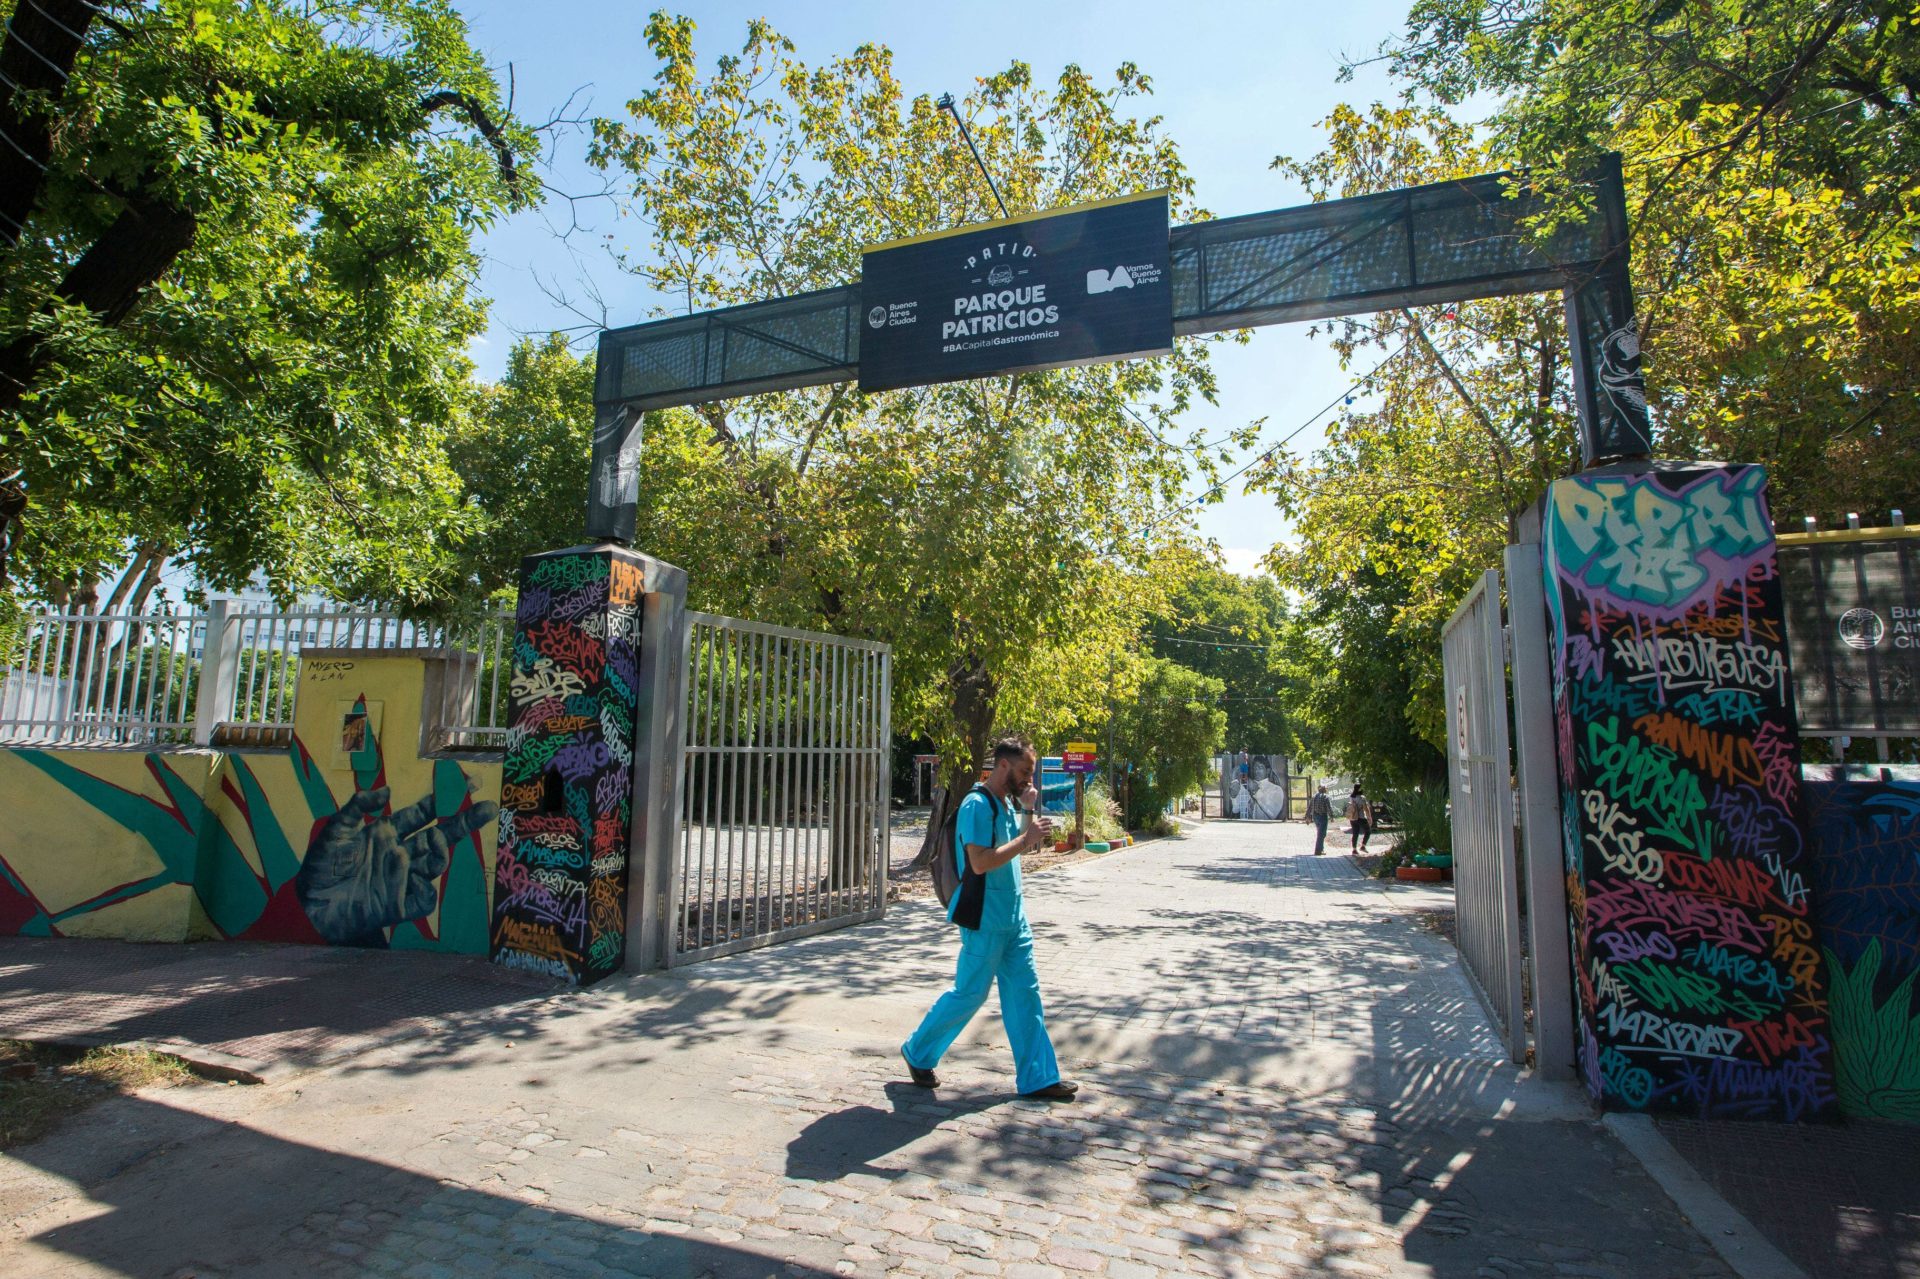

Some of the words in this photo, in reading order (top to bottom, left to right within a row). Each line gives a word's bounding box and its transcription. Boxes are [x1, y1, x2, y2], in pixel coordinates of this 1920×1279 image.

[967, 242, 1033, 268] PATIO
[1126, 263, 1154, 273] Vamos
[1131, 269, 1162, 279] Buenos
[1136, 276, 1159, 285] Aires
[954, 284, 1046, 316] PARQUE
[889, 301, 918, 311] Buenos
[889, 310, 910, 319] Aires
[889, 315, 917, 326] Ciudad
[942, 305, 1059, 340] PATRICIOS
[942, 330, 1060, 353] #BACapitalGastronómica
[311, 674, 345, 682] ALAN
